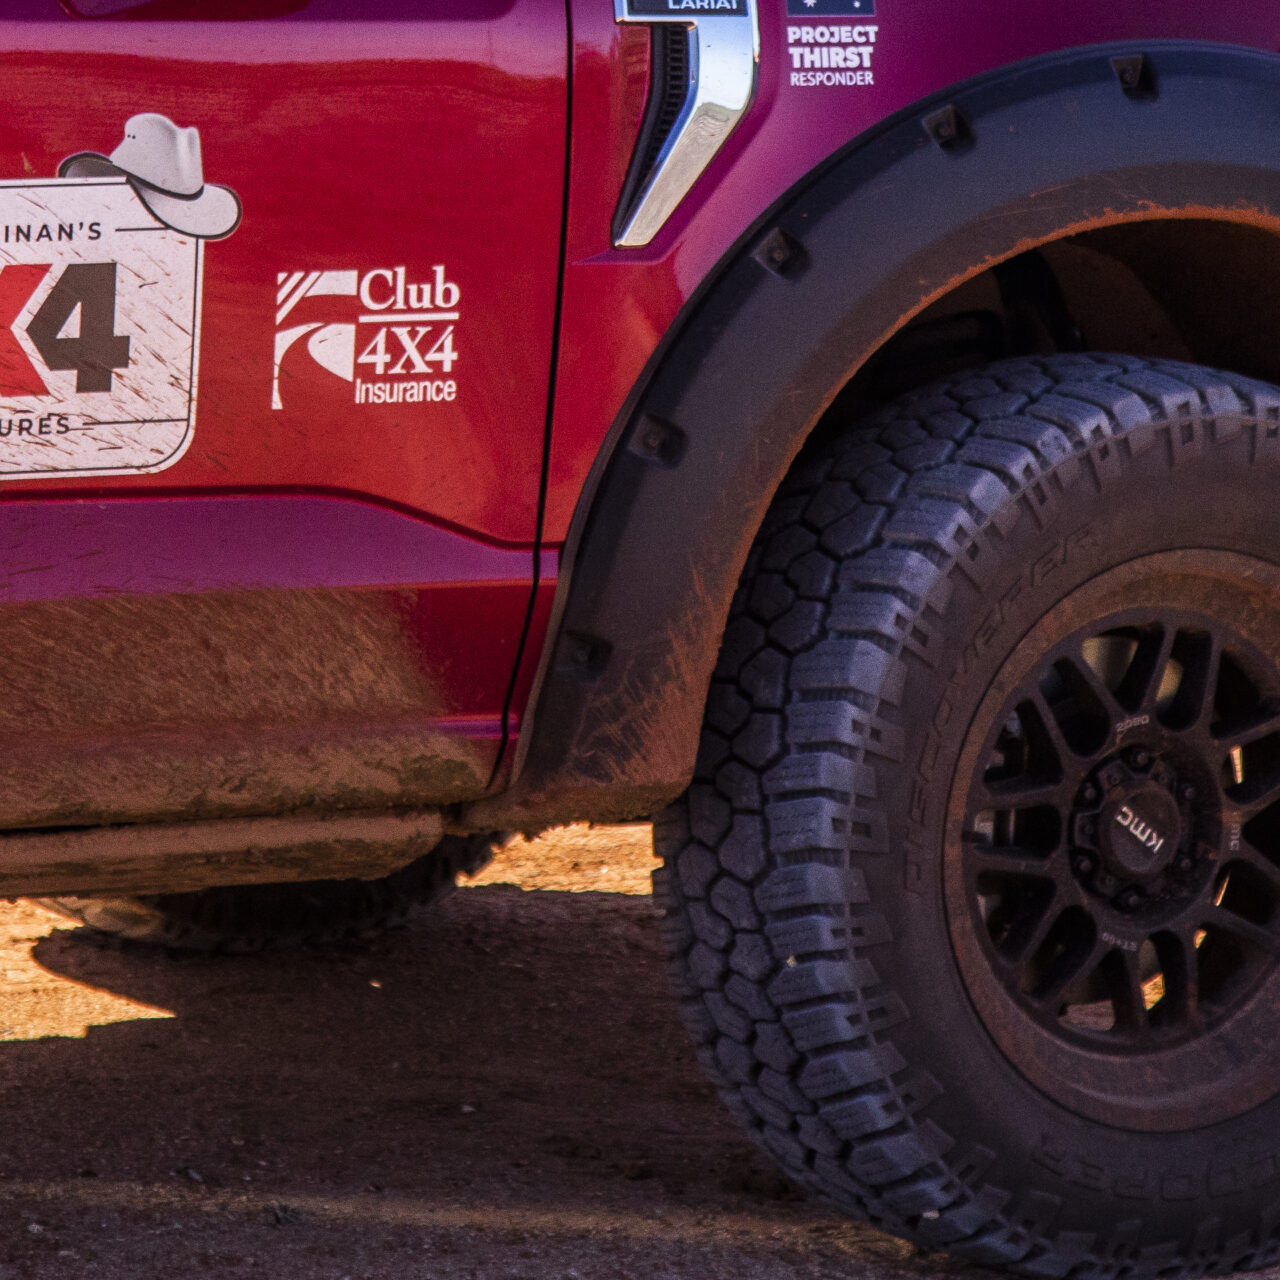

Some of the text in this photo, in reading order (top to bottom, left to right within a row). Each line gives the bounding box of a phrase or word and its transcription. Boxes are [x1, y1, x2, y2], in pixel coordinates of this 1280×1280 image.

[786, 24, 878, 44] PROJECT
[788, 46, 874, 69] THIRST
[790, 71, 874, 87] RESPONDER
[359, 265, 461, 310] Club
[356, 323, 458, 376] 4X4
[355, 378, 457, 404] Insurance
